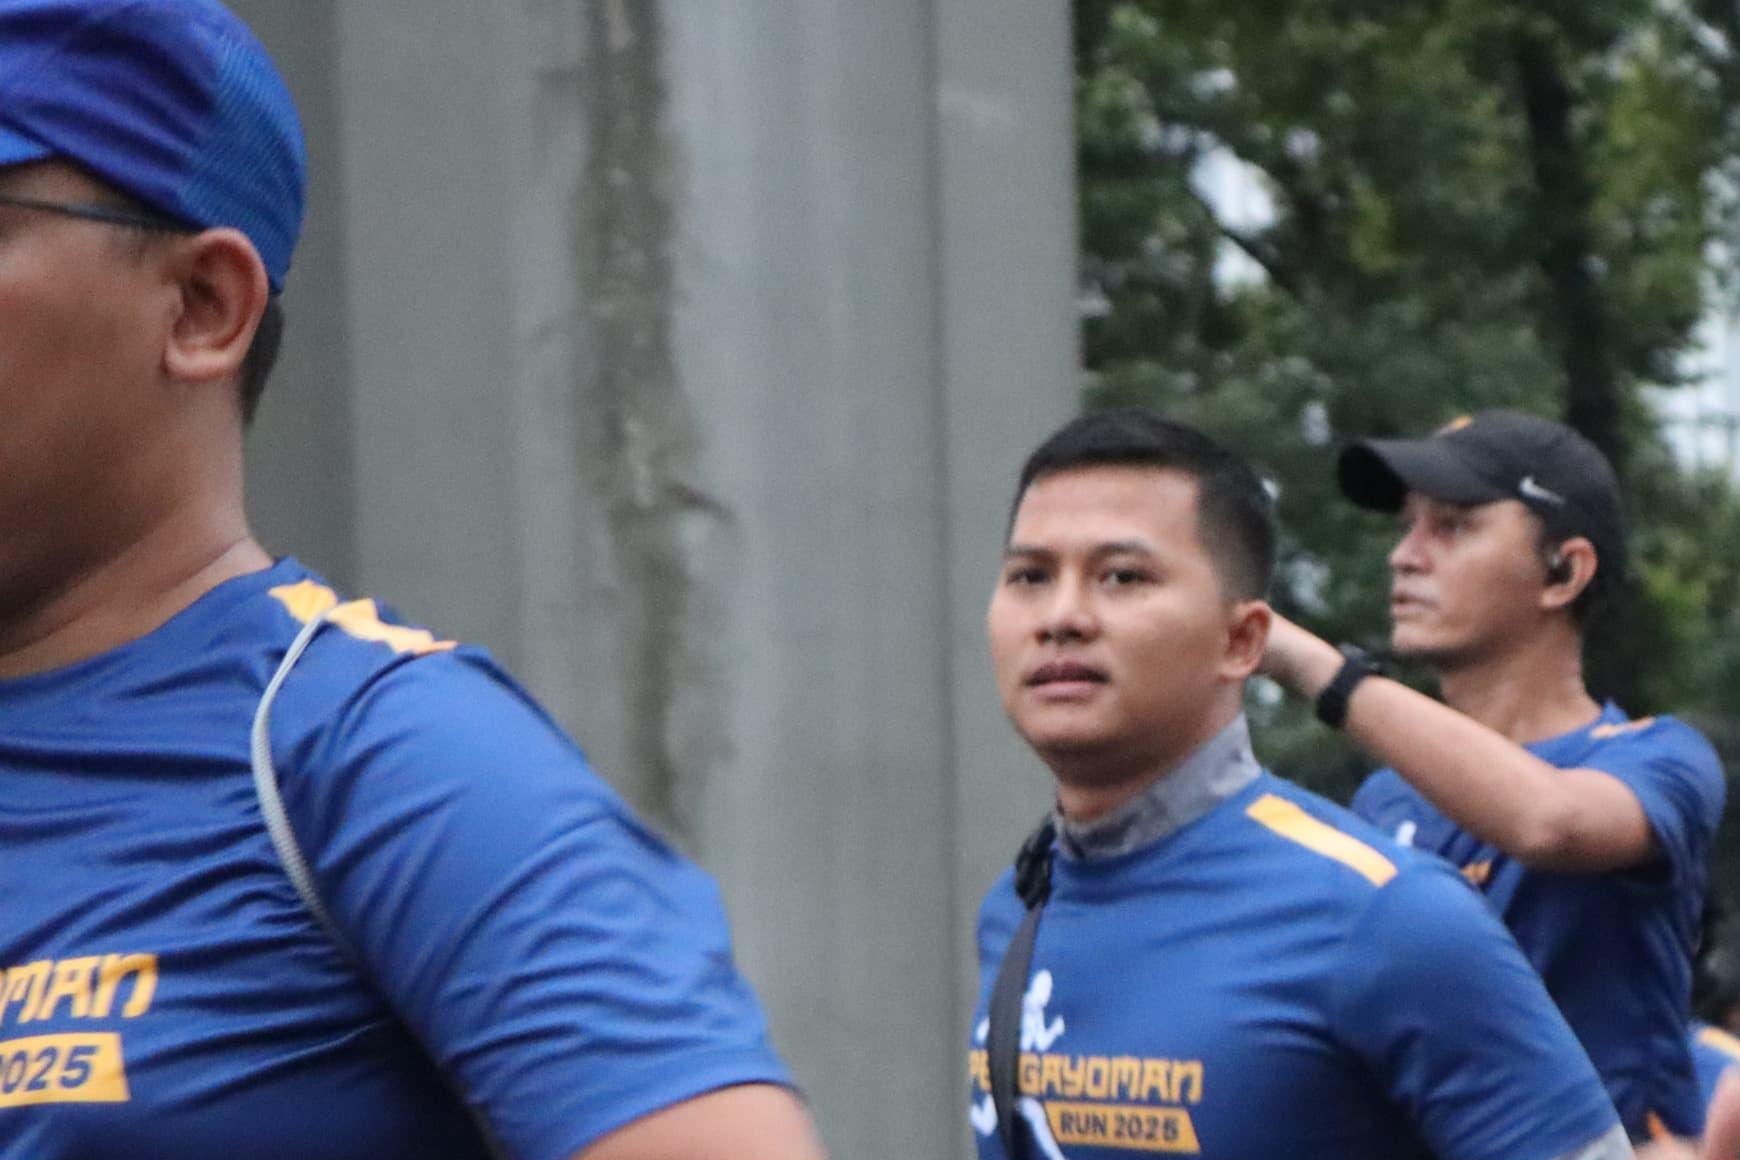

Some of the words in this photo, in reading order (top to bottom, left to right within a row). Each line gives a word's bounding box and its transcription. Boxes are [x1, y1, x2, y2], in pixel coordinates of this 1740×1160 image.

[0, 953, 160, 1027] MAN
[0, 1045, 99, 1095] 025
[968, 1049, 1204, 1104] PEGAYOMAN
[1059, 1109, 1108, 1137] RUN
[1114, 1112, 1180, 1142] 2025
